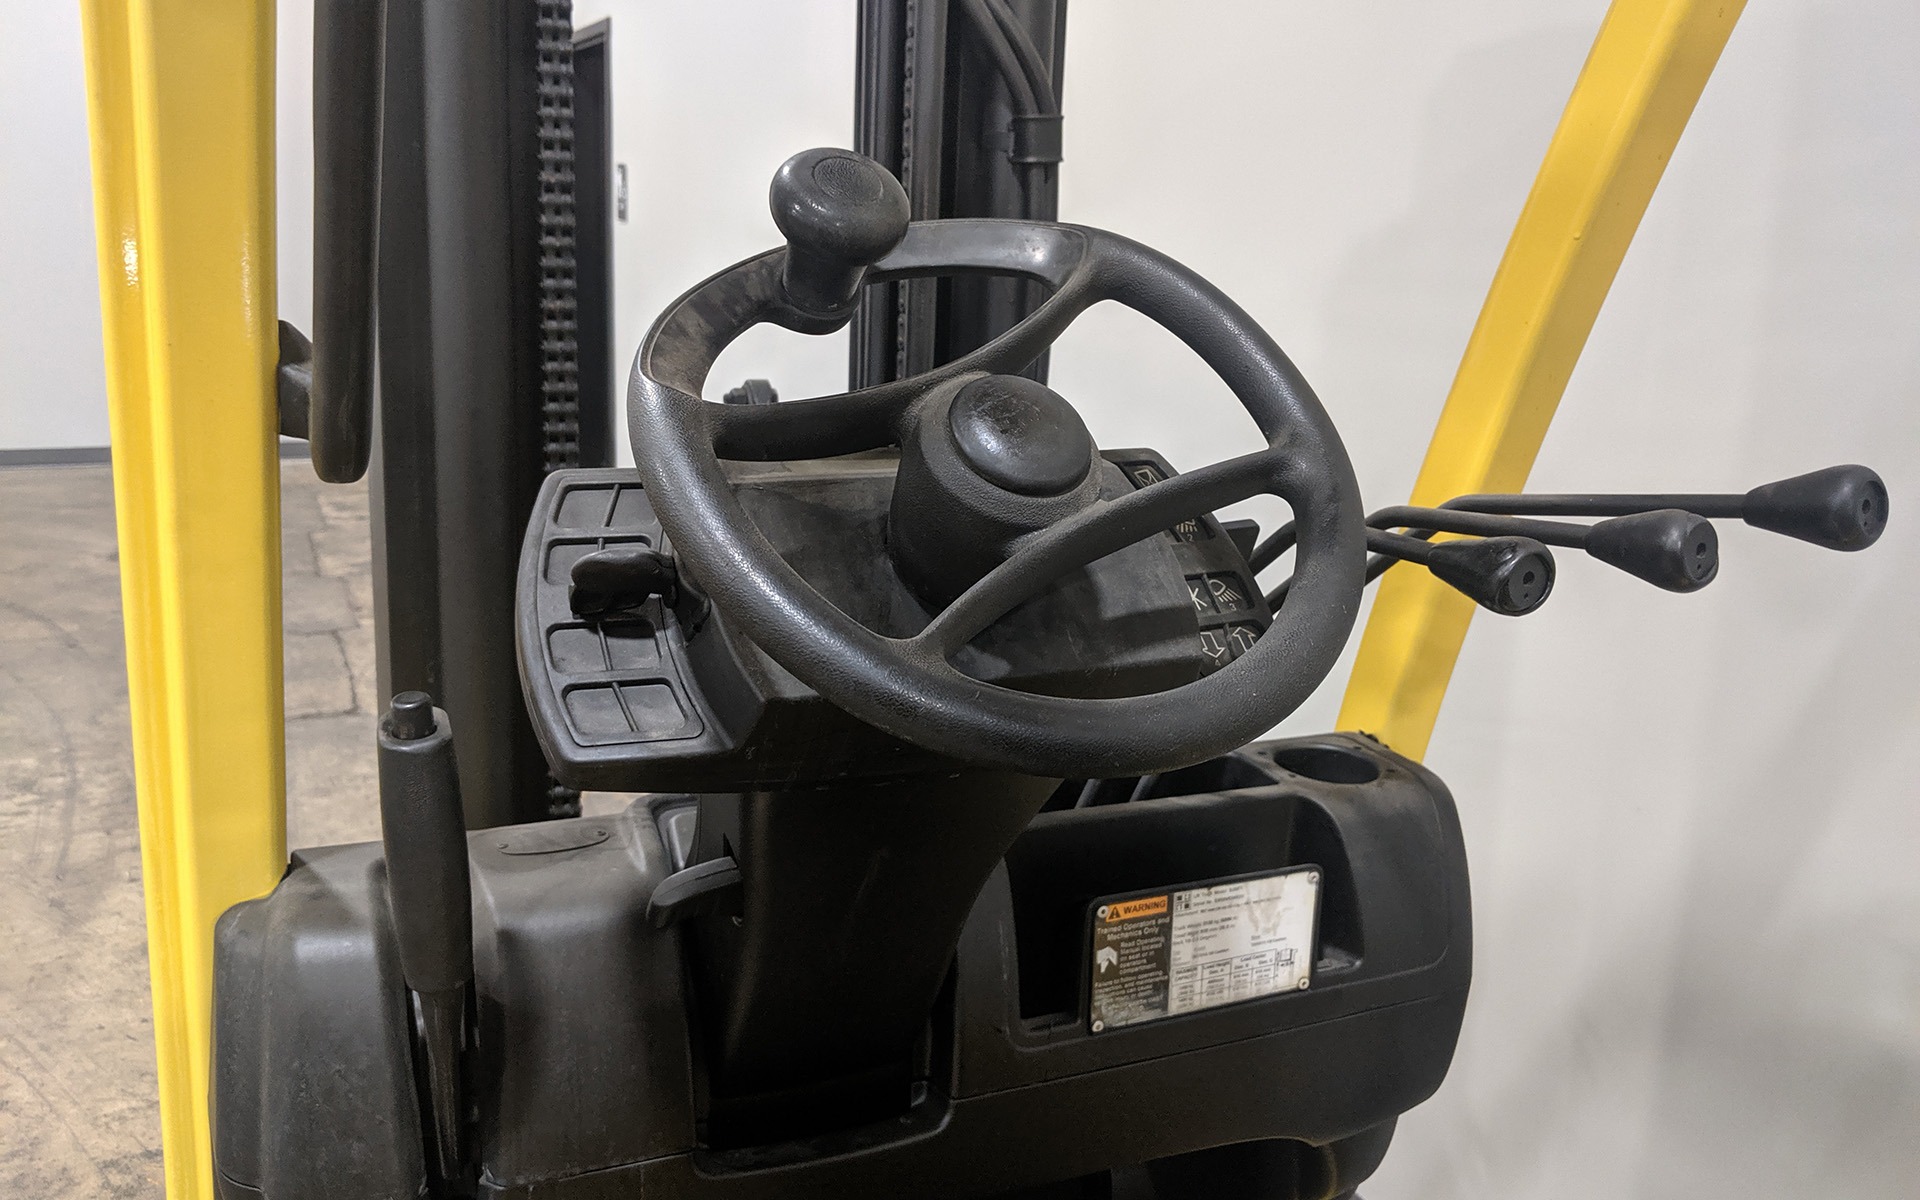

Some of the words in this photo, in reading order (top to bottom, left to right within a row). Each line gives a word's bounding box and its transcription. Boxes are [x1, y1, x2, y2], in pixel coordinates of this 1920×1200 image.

[1229, 602, 1237, 611] 3
[1123, 899, 1166, 914] WARNING
[1123, 918, 1156, 931] Operators
[1157, 915, 1170, 924] and
[1106, 929, 1142, 941] Mechanics
[1143, 926, 1160, 935] Only
